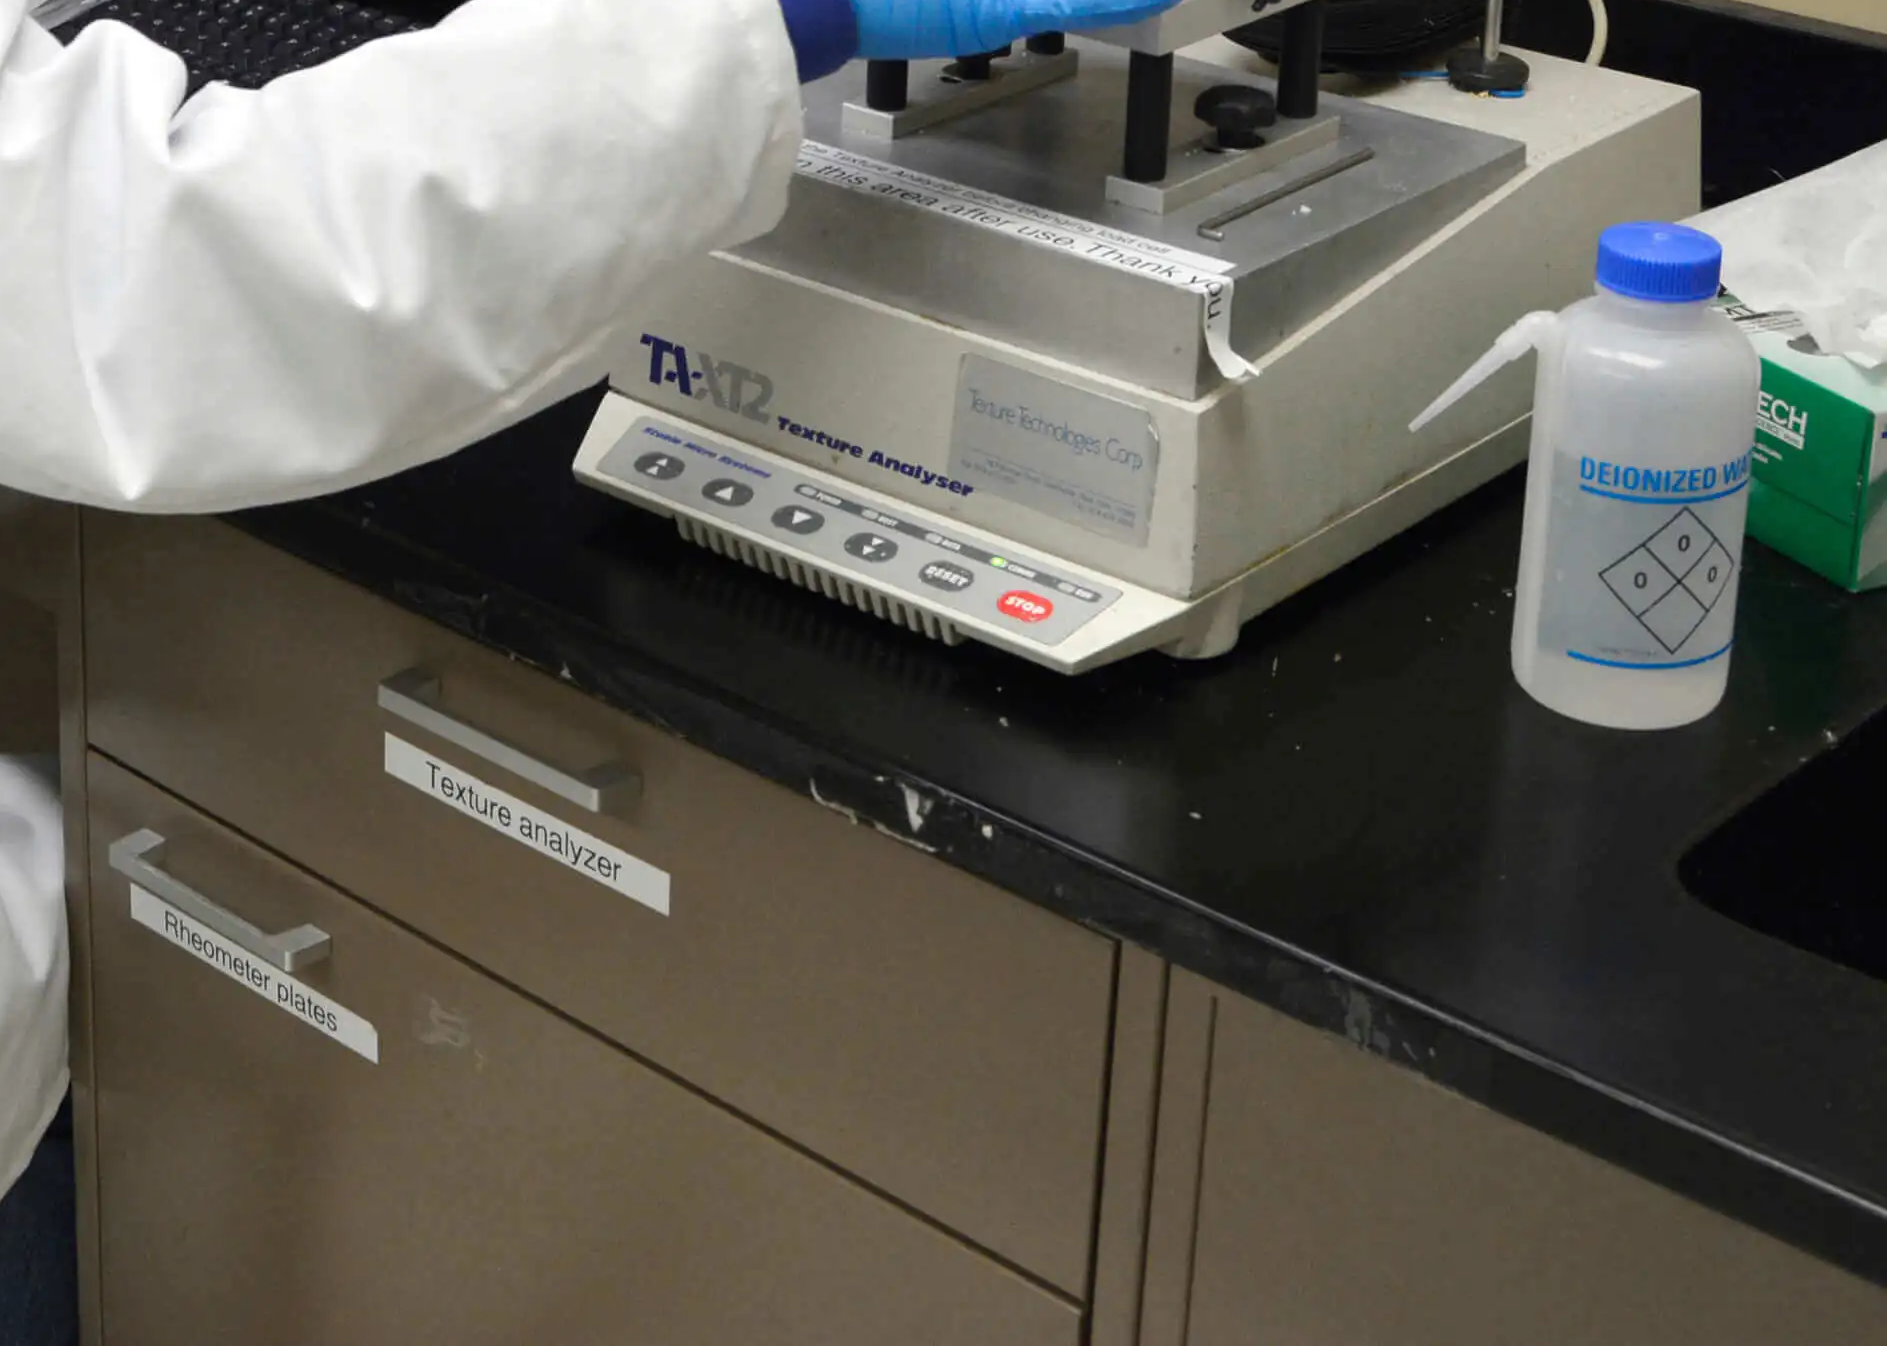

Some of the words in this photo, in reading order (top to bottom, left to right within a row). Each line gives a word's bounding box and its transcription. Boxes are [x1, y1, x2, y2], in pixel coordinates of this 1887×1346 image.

[816, 164, 868, 186] this
[870, 182, 940, 206] area
[942, 204, 1017, 228] after
[1017, 225, 1076, 250] use.
[1085, 242, 1183, 278] Thank
[777, 415, 864, 458] Texture
[867, 450, 975, 498] Analyser
[1580, 456, 1716, 493] DEIONIZED
[1677, 535, 1690, 552] 0
[925, 565, 968, 587] RESET
[1005, 595, 1046, 615] STOP
[1634, 571, 1648, 589] 0
[1707, 566, 1718, 583] 0
[425, 761, 512, 827] Texture
[519, 816, 622, 881] analyzer
[164, 910, 271, 991] Rheometer
[277, 983, 338, 1032] plates
